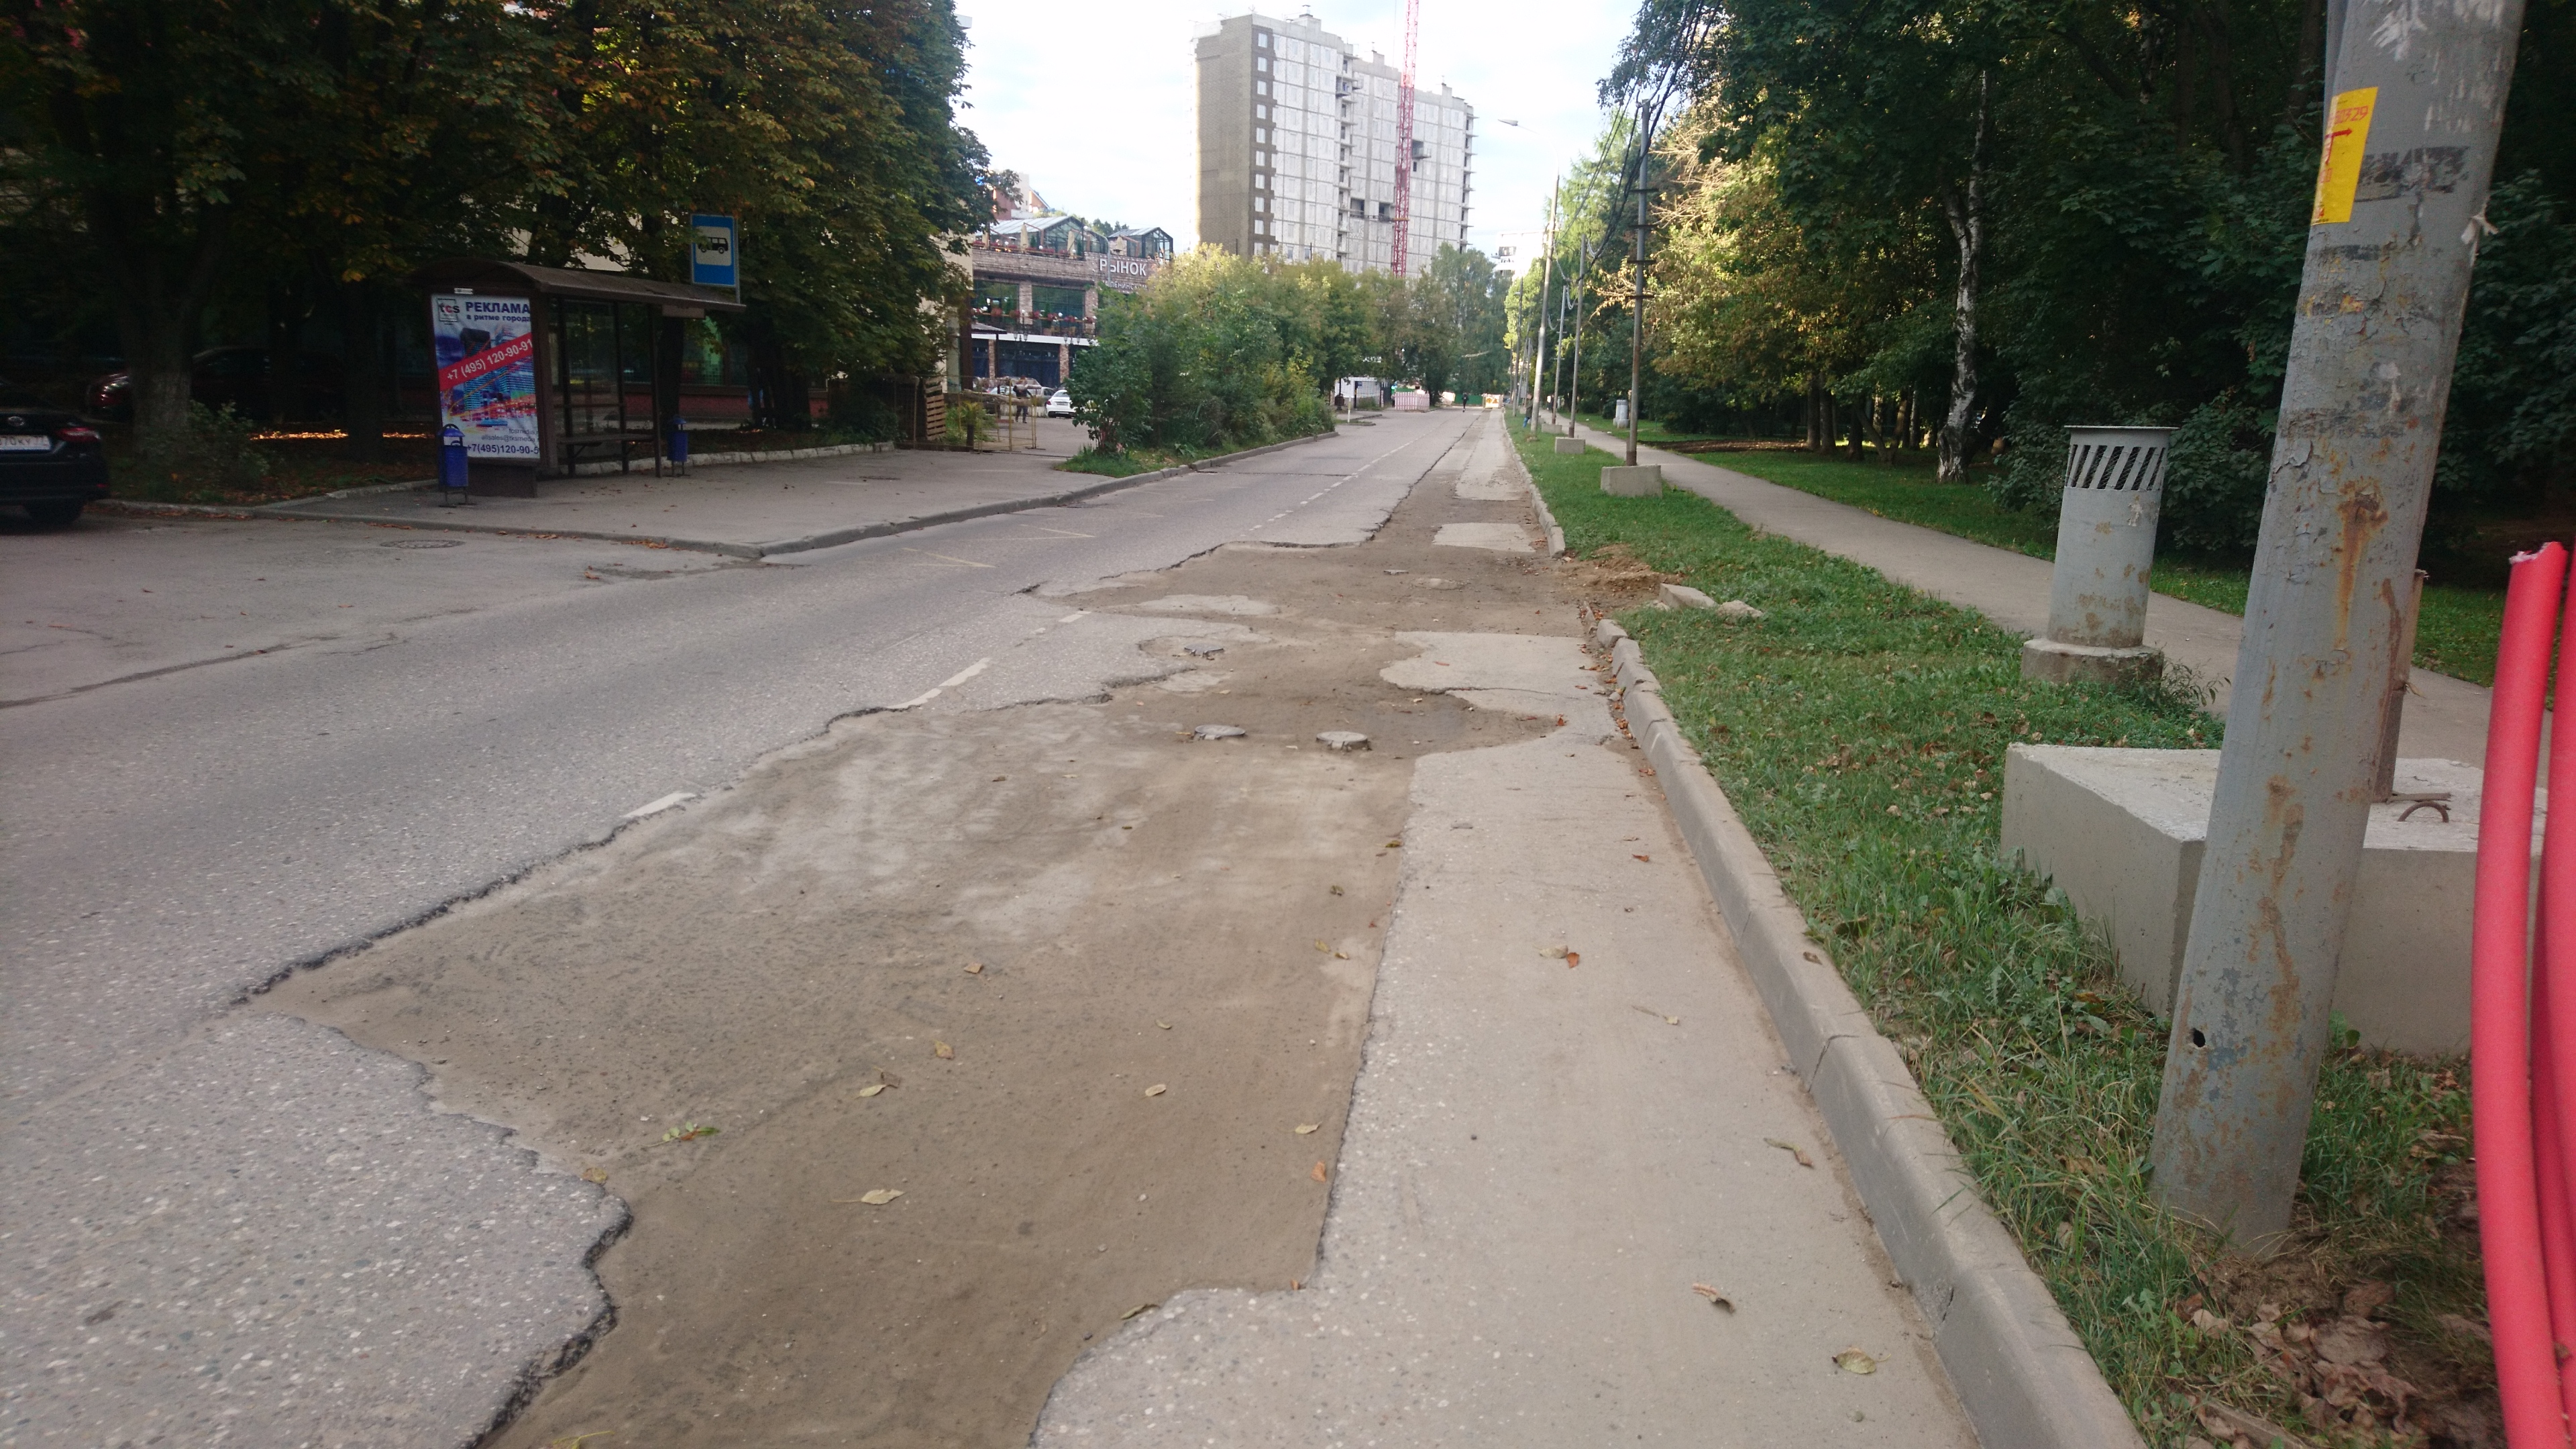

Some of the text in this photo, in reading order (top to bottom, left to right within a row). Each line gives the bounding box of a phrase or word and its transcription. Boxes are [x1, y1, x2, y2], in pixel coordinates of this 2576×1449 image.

[1099, 258, 1146, 276] РЫНОК
[438, 303, 460, 313] tcs
[465, 301, 530, 314] РЕКЛАМА
[447, 339, 533, 380] +7 (495) 120-90-91
